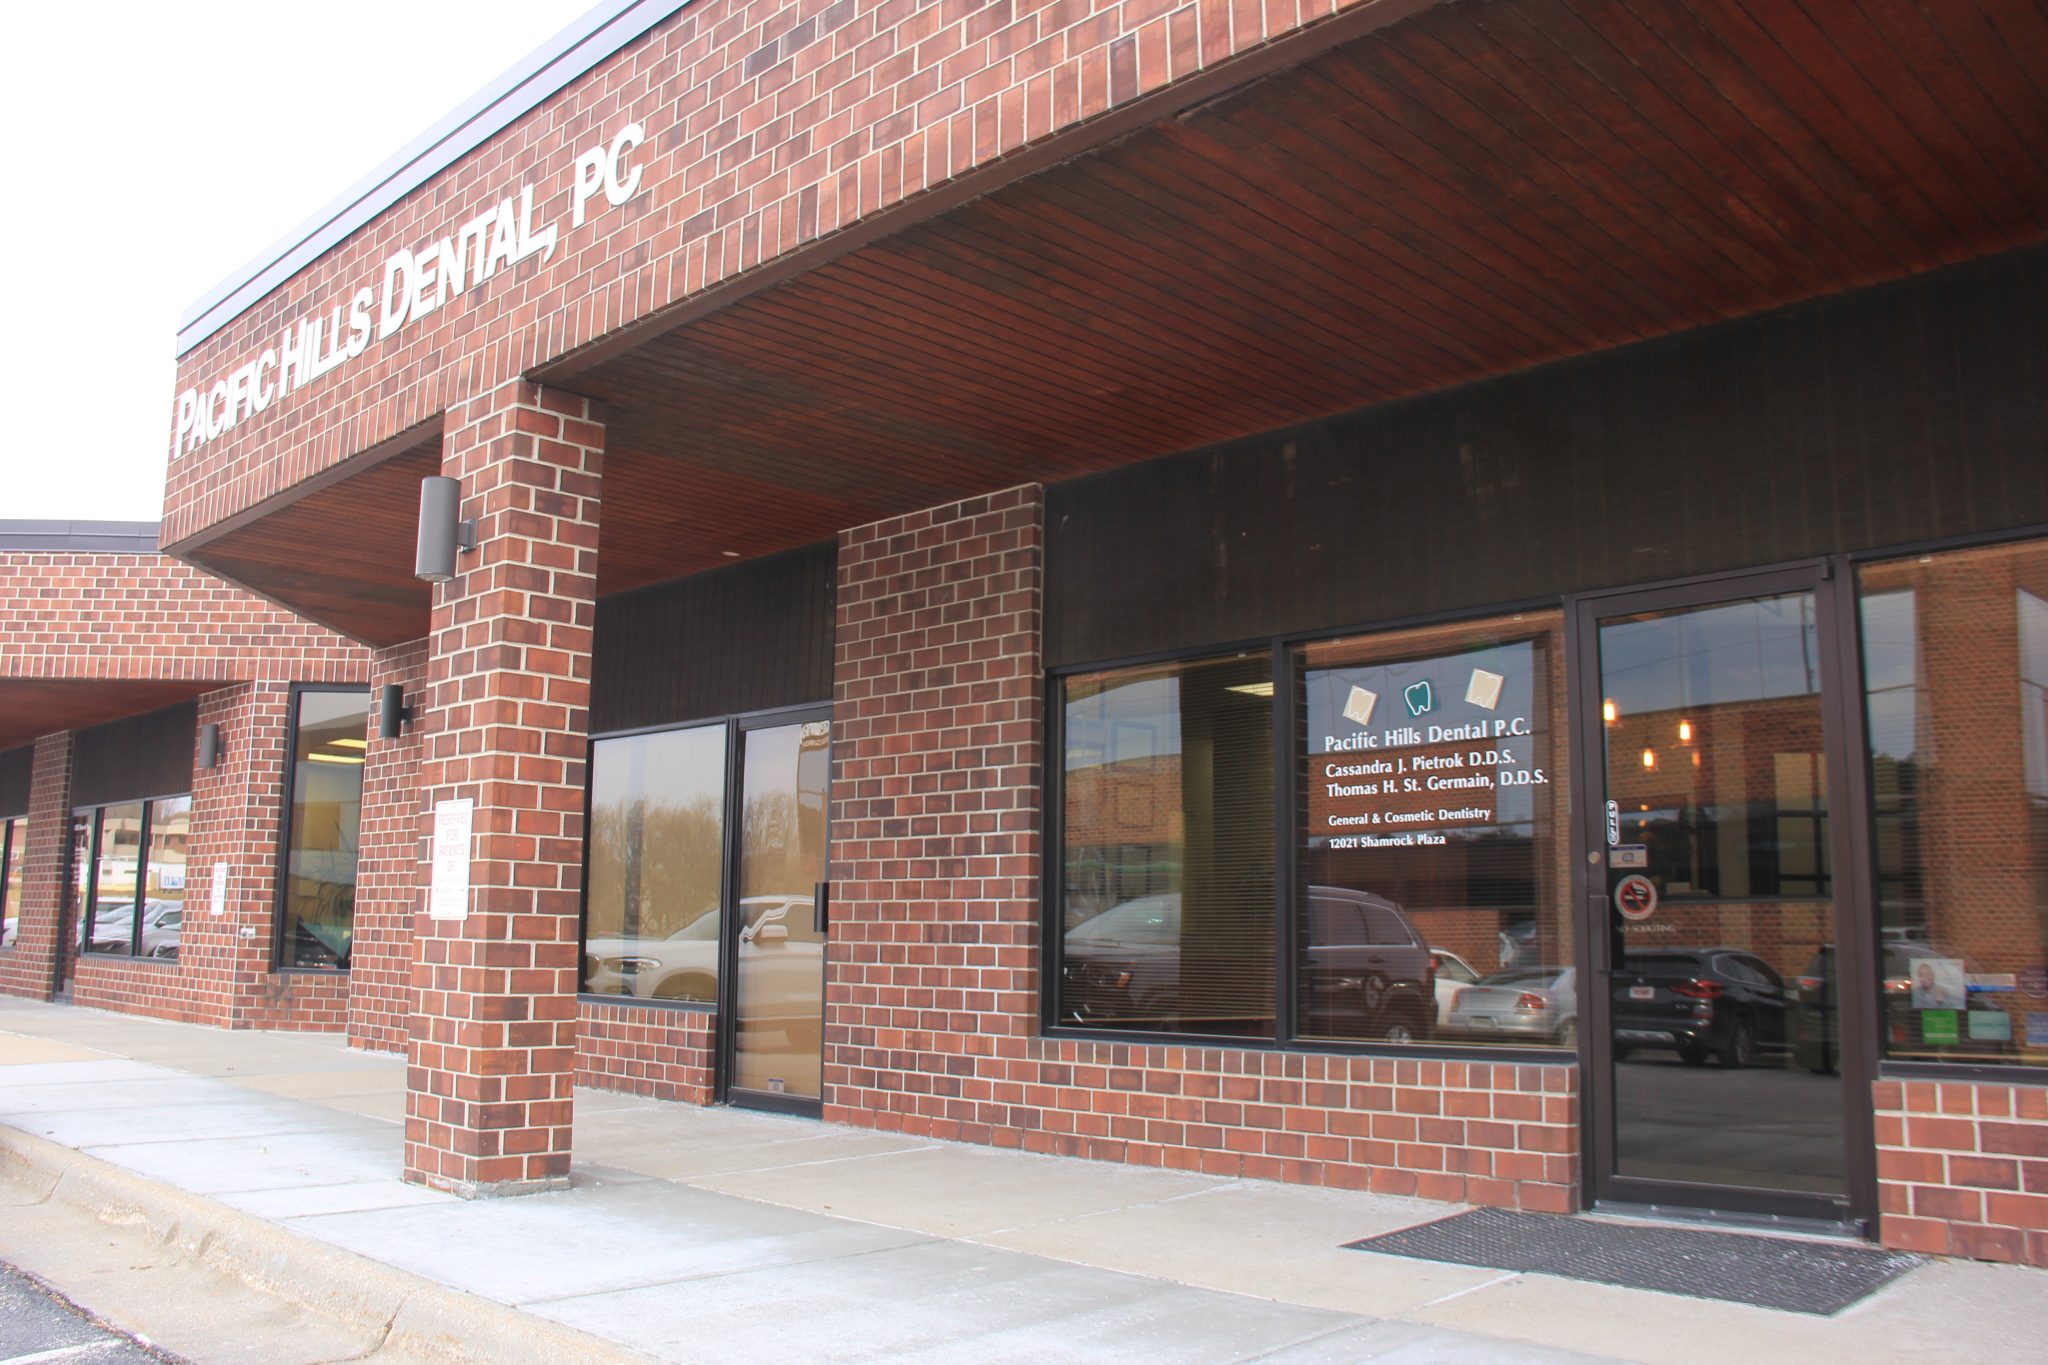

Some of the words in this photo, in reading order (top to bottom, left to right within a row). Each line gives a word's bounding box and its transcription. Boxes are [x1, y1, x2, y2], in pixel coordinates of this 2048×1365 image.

[173, 348, 277, 459] PACIFIC
[278, 286, 372, 399] HILLS
[379, 183, 558, 340] DENTAL,
[572, 123, 645, 229] PC
[1325, 732, 1377, 752] Pacific
[1385, 727, 1421, 747] Hills
[1428, 720, 1488, 743] Dental
[1494, 717, 1531, 737] P.C.
[1325, 759, 1392, 778] Cassandra
[1397, 759, 1407, 775] J.
[1412, 752, 1464, 771] Pietrok
[1469, 749, 1516, 767] D.D.S.
[1327, 781, 1378, 797] Thomas
[1383, 780, 1398, 794] H.
[1404, 777, 1422, 792] St.
[1427, 772, 1495, 791] Germain,
[1500, 769, 1549, 786] D.D.S.
[1328, 813, 1368, 826] General
[1372, 813, 1381, 824] &
[1385, 809, 1434, 823] Cosmetic
[1438, 806, 1491, 821] Dentistry
[1329, 837, 1358, 849] 12021
[1361, 834, 1414, 847] Shamrock
[1417, 833, 1446, 845] Plaza
